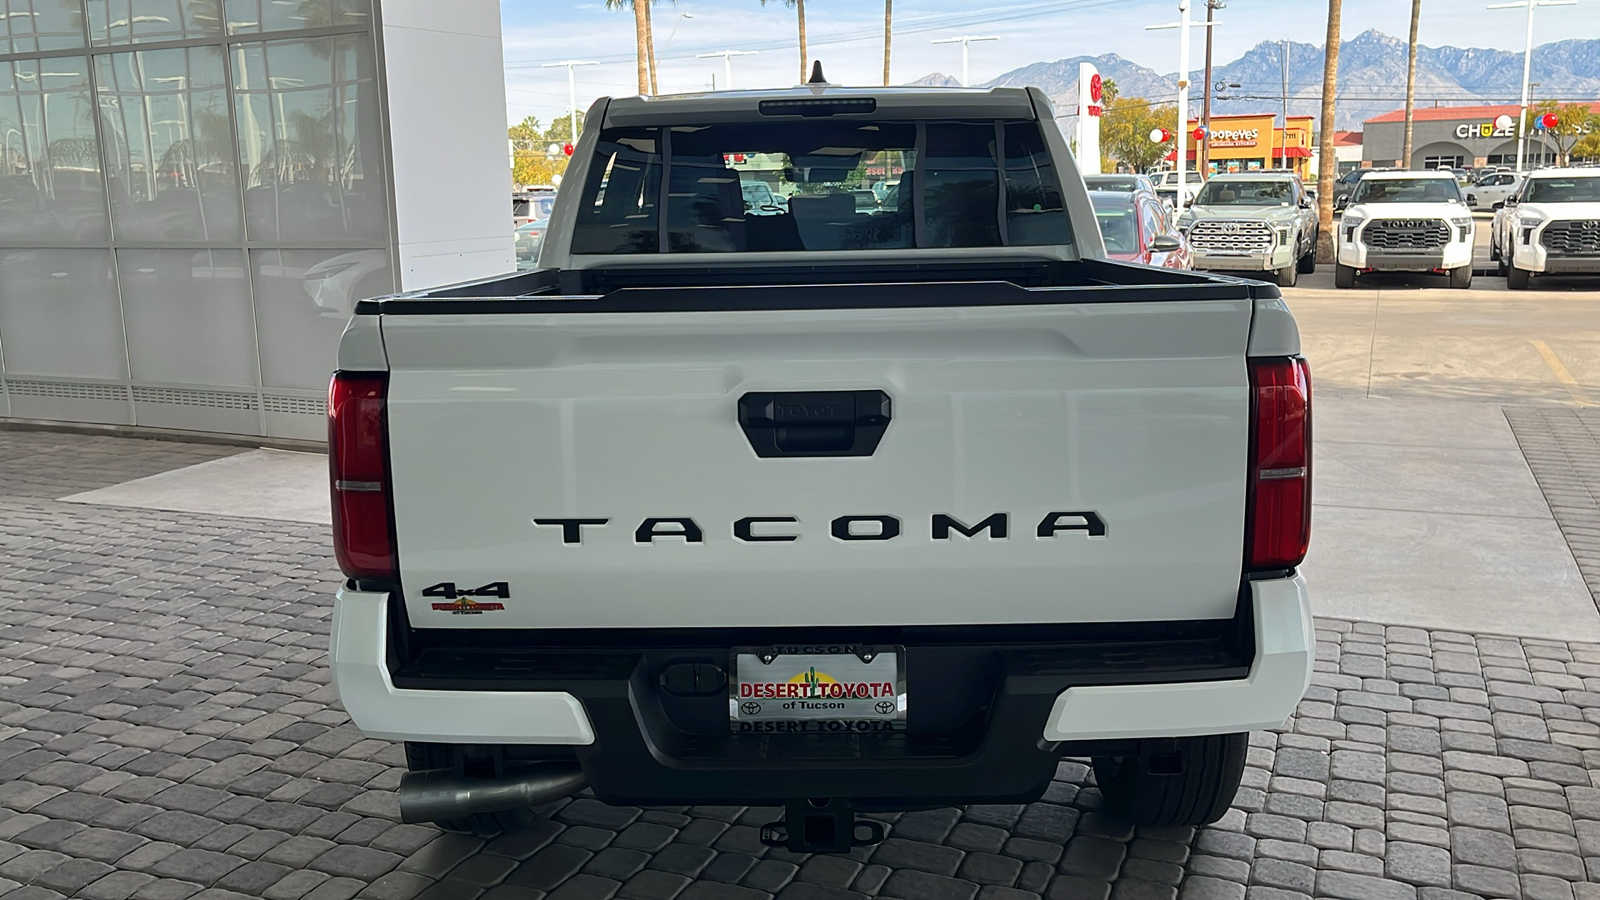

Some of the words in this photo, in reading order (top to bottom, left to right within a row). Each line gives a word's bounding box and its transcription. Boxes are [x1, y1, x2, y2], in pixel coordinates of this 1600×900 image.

[533, 510, 1107, 544] TACOMA
[422, 582, 510, 599] 4x4
[774, 645, 857, 654] TUCSON
[740, 683, 812, 698] DESERT
[818, 682, 894, 698] TOYOTA
[783, 701, 797, 710] of
[800, 701, 845, 710] Tucson
[740, 720, 808, 732] DESERT
[817, 720, 894, 732] TOYOTA
